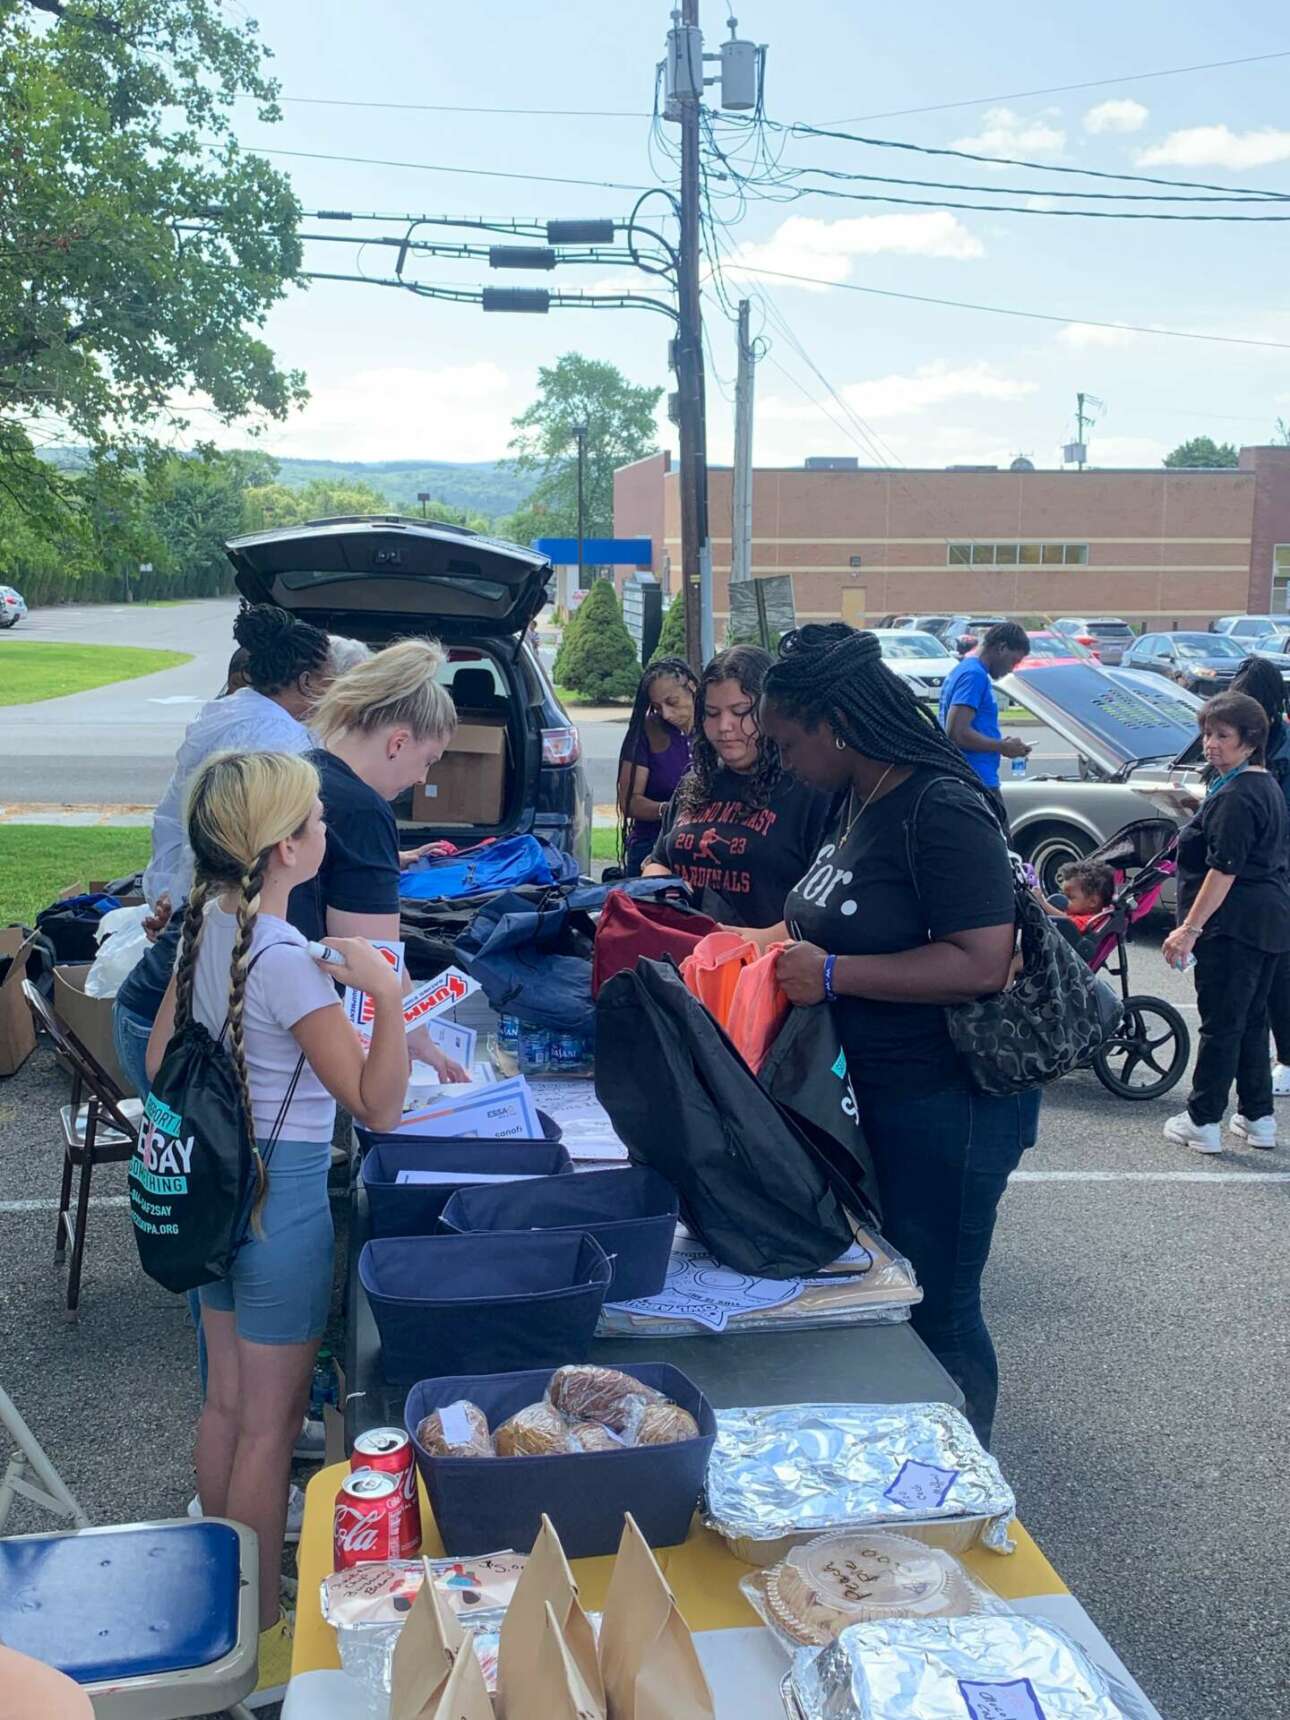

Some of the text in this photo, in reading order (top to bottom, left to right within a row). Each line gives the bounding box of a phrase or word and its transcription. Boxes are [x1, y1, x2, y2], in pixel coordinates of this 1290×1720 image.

[741, 808, 778, 836] AST
[675, 832, 748, 855] 20 23
[403, 974, 467, 1023] SUMM
